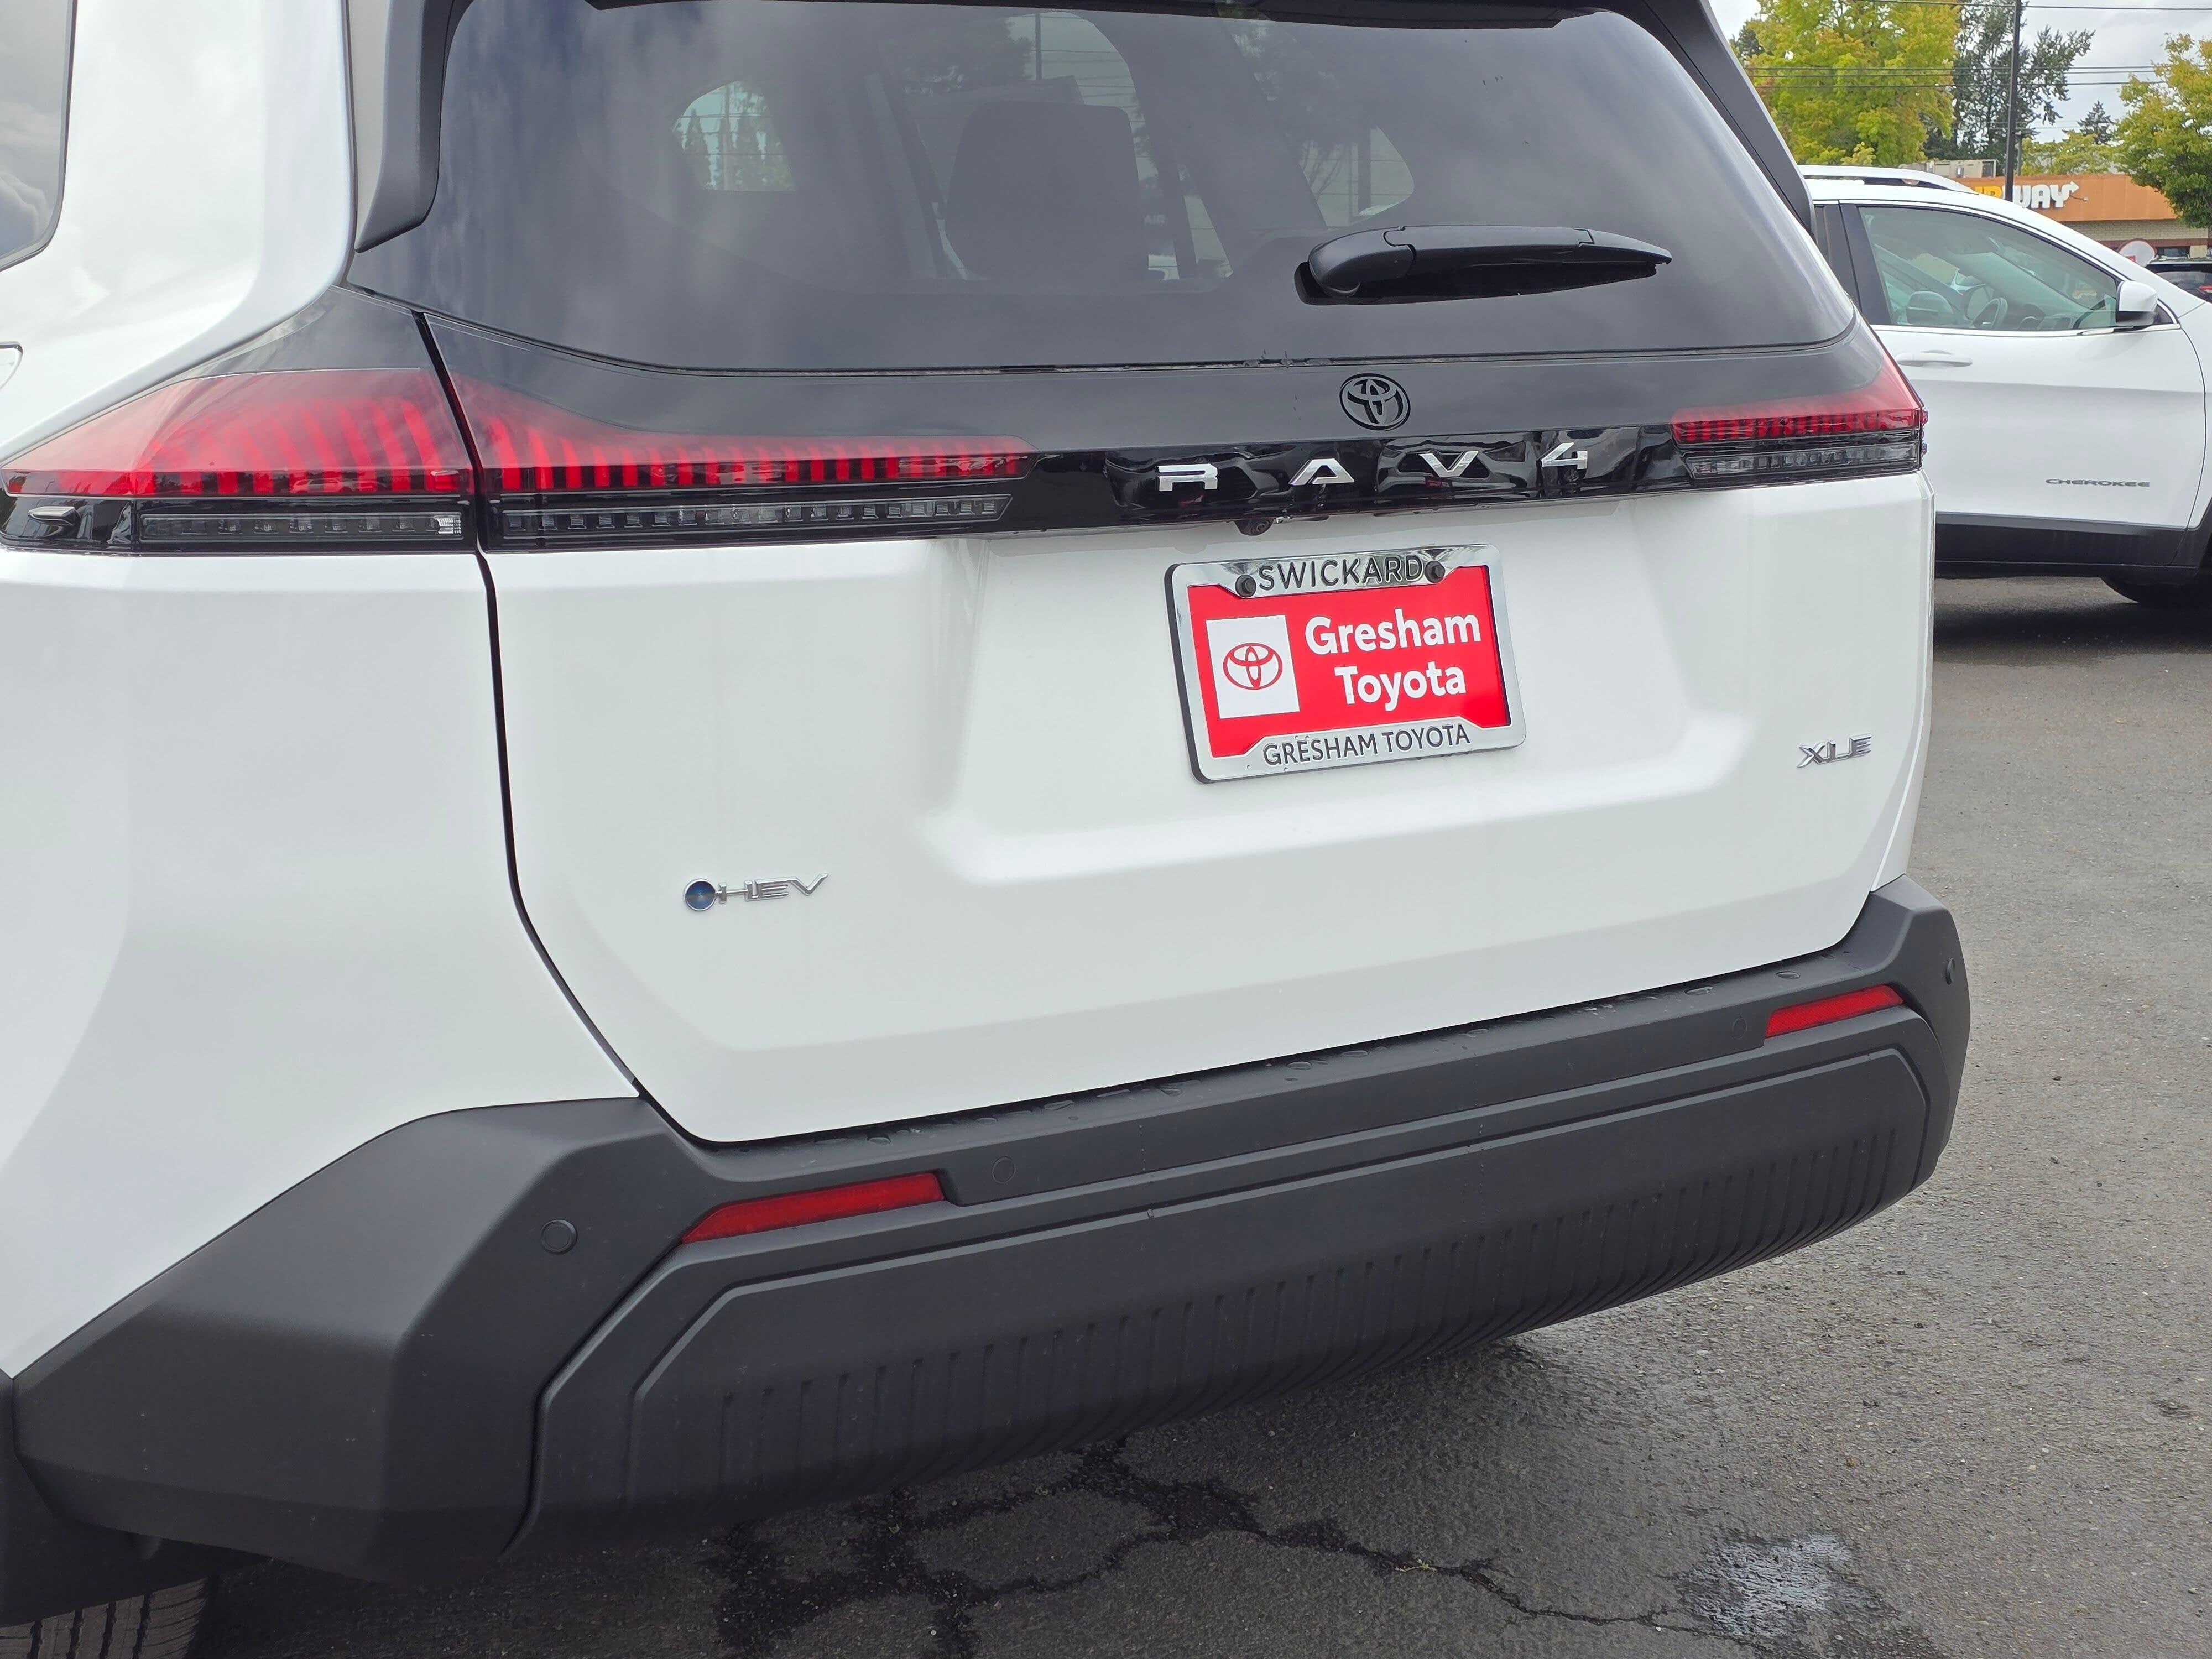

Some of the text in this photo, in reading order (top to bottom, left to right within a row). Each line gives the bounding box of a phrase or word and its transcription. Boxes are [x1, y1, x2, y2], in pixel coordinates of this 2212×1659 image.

[1157, 442, 1588, 493] RAV4
[2045, 478, 2151, 487] CHEROKEE
[1258, 555, 1424, 591] SWICKARD
[1304, 608, 1481, 655] Gresham
[1334, 661, 1467, 712] Toyota
[1262, 723, 1471, 766] GRESHAM TOYOTA
[1797, 733, 1872, 768] XLE
